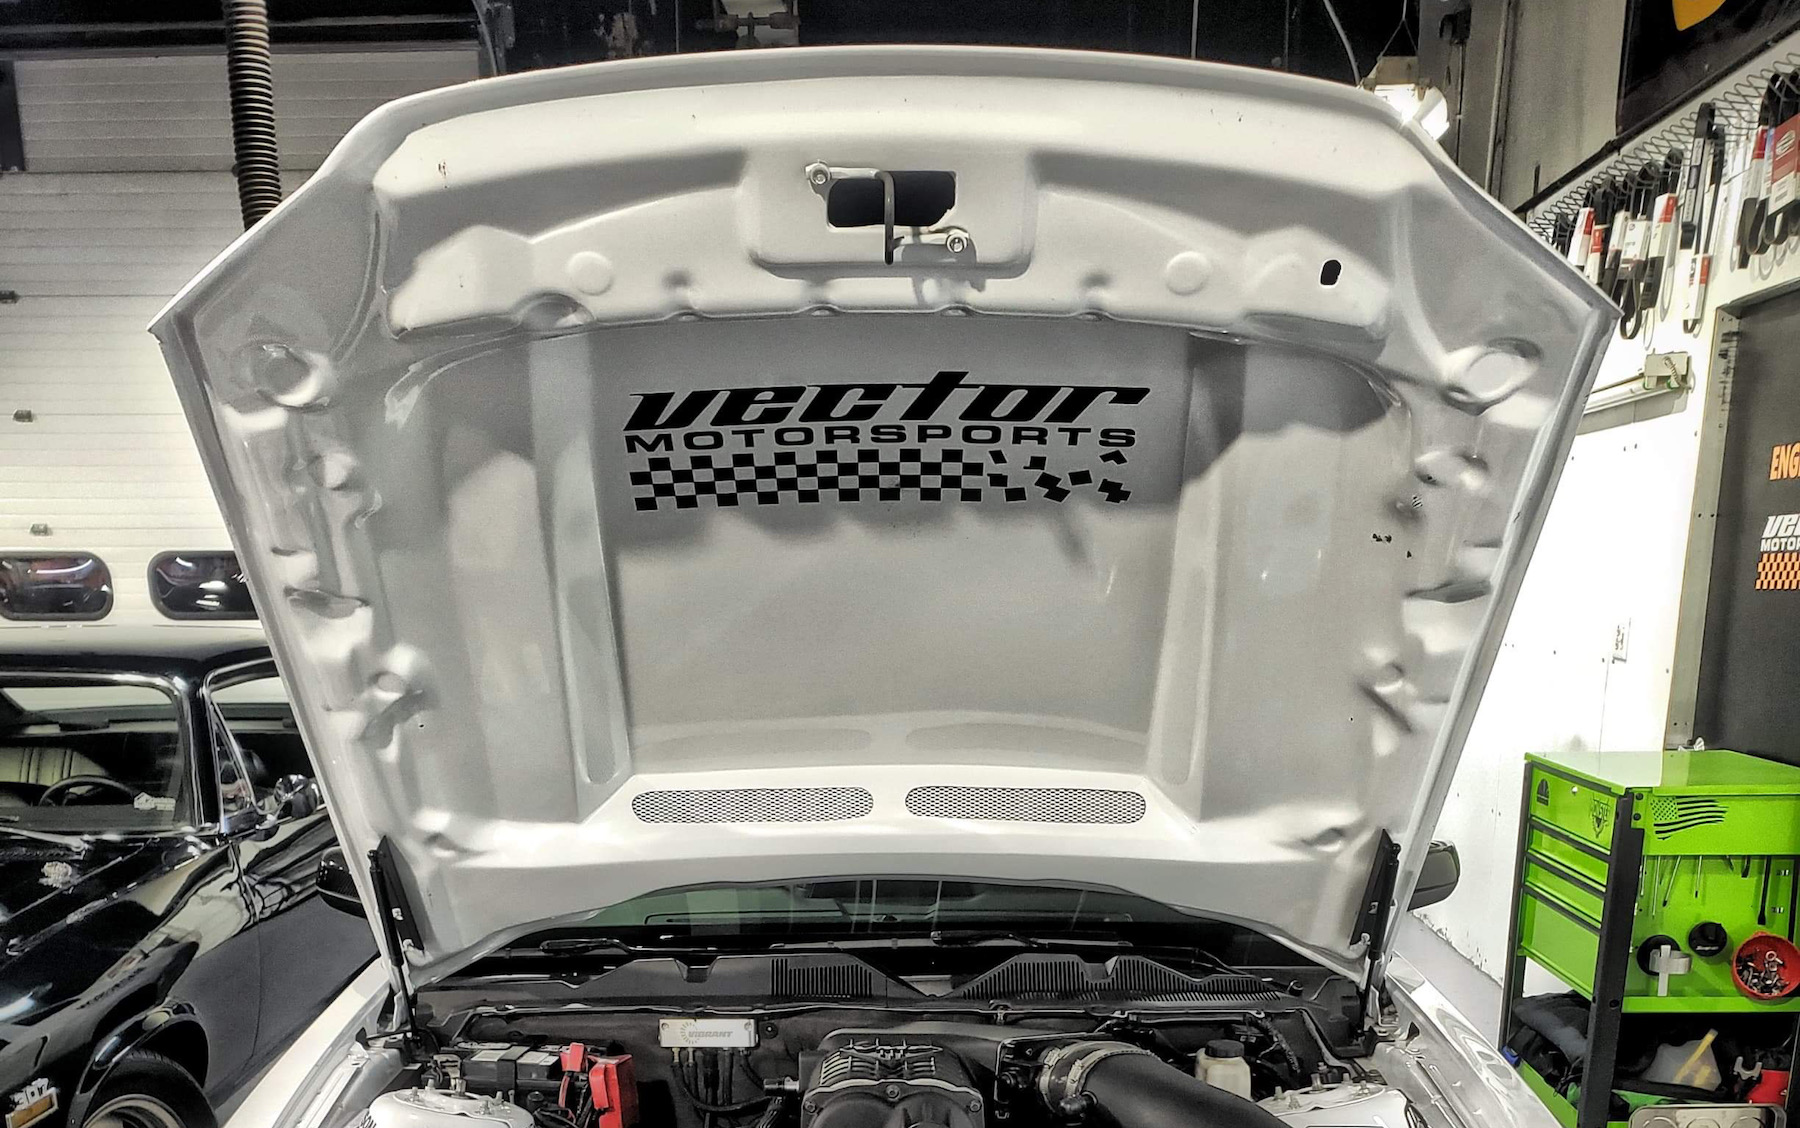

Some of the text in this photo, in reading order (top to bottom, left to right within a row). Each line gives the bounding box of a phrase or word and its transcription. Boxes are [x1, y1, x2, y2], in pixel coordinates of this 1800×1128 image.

[623, 370, 1151, 431] vector
[624, 424, 1137, 453] MOTORSPORTS
[1769, 442, 1800, 481] ENG
[688, 1030, 734, 1038] VIBRANT
